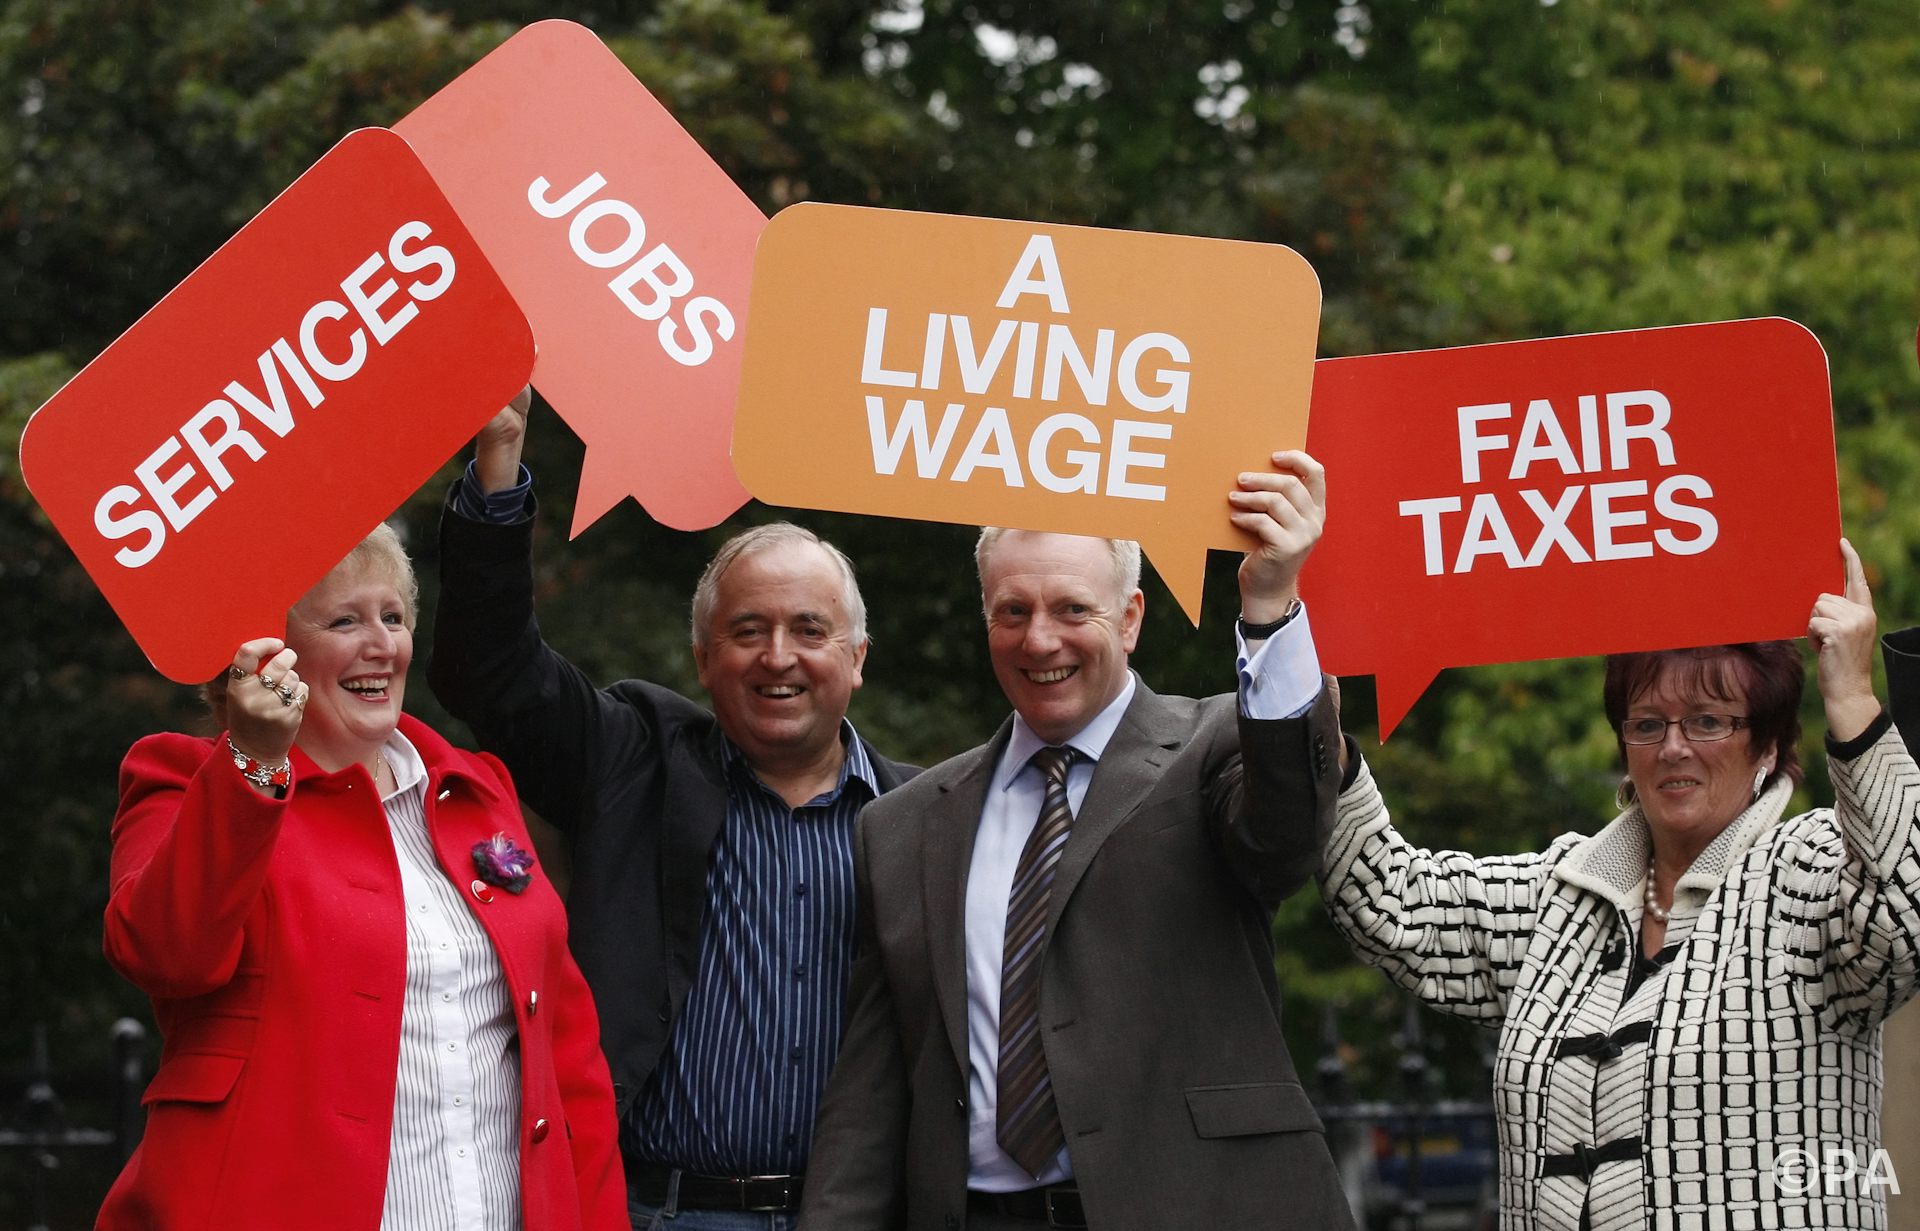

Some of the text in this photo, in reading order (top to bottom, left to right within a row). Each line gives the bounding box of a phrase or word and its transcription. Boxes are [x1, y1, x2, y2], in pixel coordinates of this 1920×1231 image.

[527, 171, 736, 367] JOBS
[996, 235, 1071, 314] A
[94, 220, 456, 568] SERVICES
[860, 307, 1191, 414] LIVING
[864, 395, 1173, 502] WAGE
[1457, 390, 1677, 484] FAIR
[1399, 474, 1719, 576] TAXES
